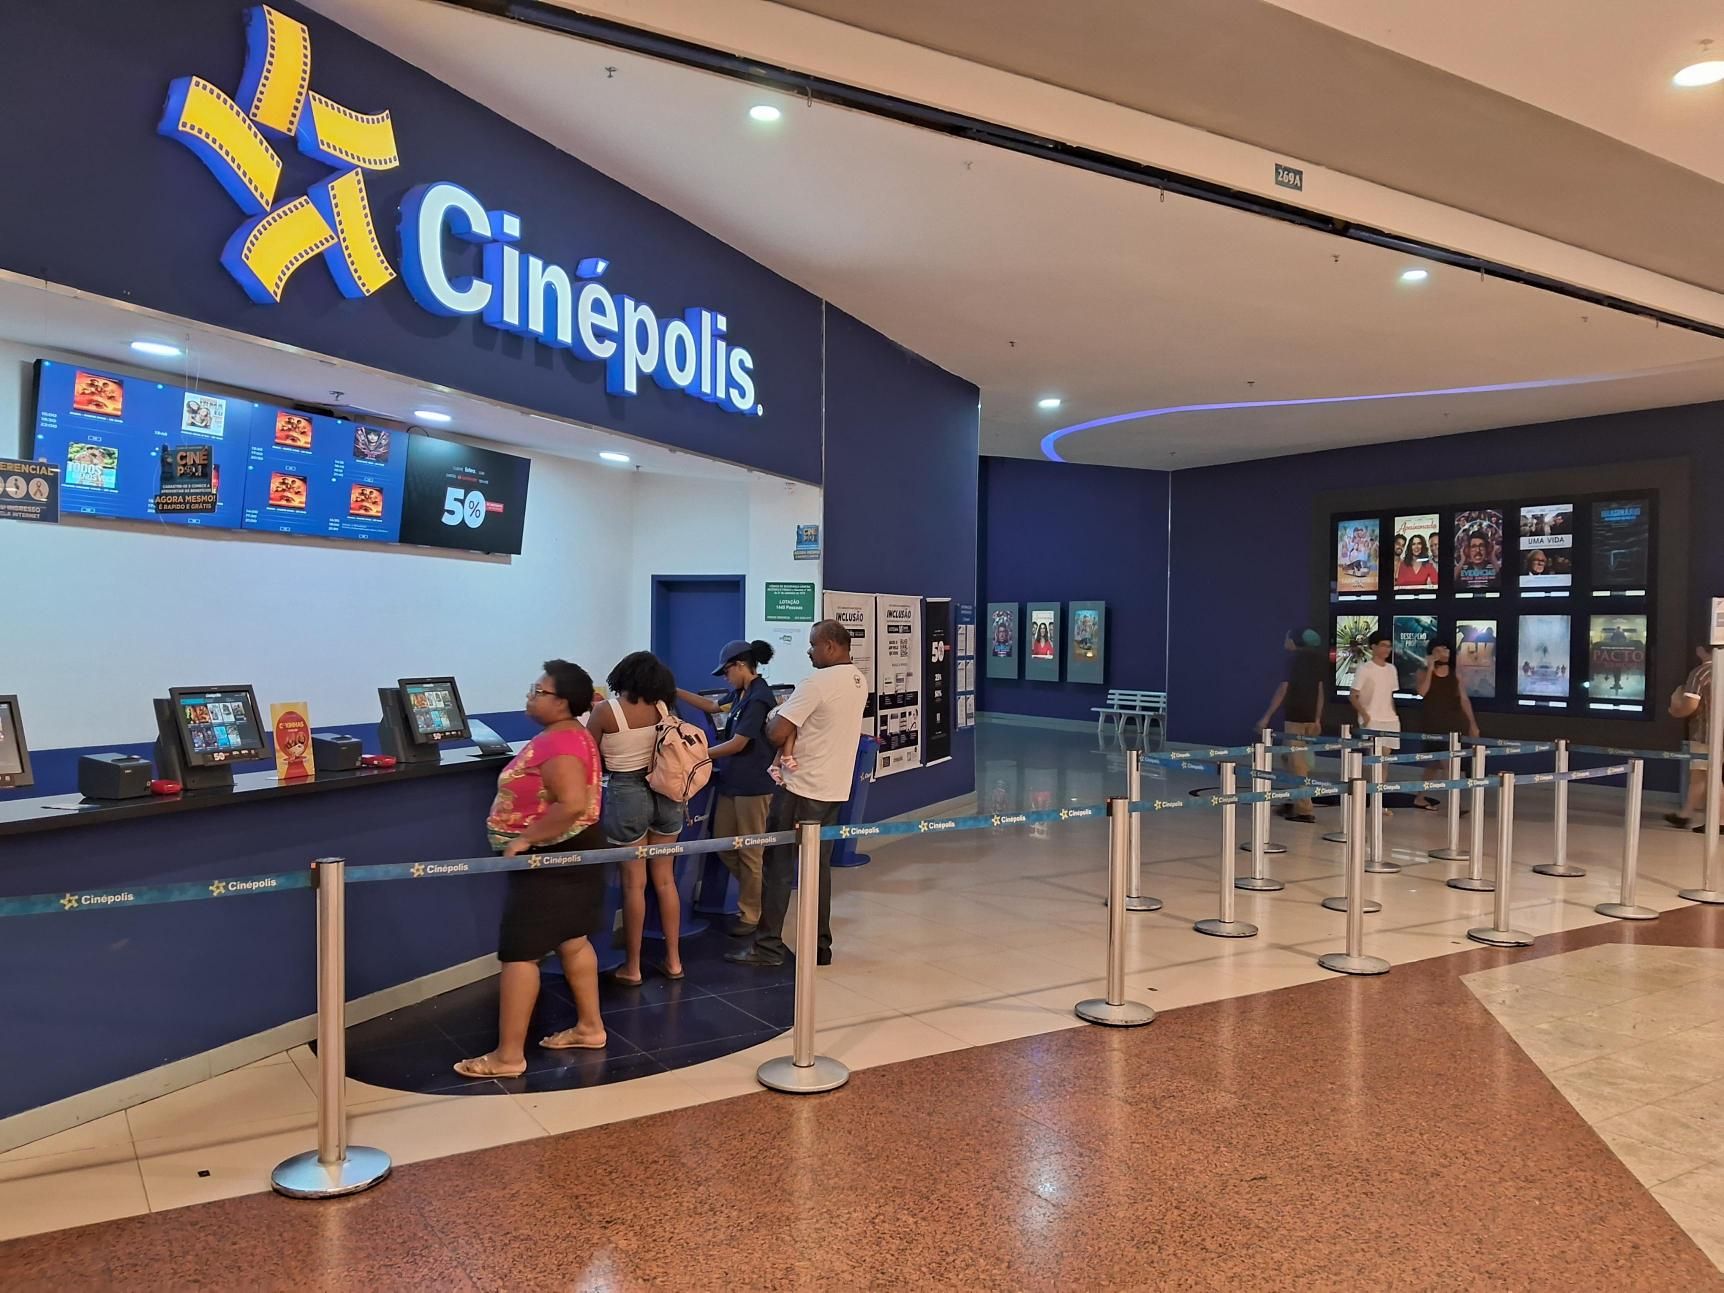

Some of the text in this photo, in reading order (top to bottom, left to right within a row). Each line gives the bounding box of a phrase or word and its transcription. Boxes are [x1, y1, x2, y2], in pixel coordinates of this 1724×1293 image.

[1277, 169, 1301, 187] 269A
[155, 495, 216, 503] AGORA MESMO!
[1547, 536, 1565, 544] VIDA
[835, 610, 864, 622] INCLUSÃO
[886, 607, 912, 619] INCLUSÃO
[1593, 650, 1643, 663] PACTO
[1001, 814, 1026, 824] Cinépolis
[1068, 808, 1092, 818] Cinépolis
[850, 825, 880, 836] Cinépolis
[928, 820, 956, 830] Cinépolis
[744, 835, 777, 847] Cinépolis
[648, 845, 684, 857] Cinépolis
[543, 853, 582, 867] Cinépolis
[426, 862, 469, 876] Cinépolis
[228, 877, 277, 892] Cinépolis
[81, 891, 134, 905] Cinépolis
